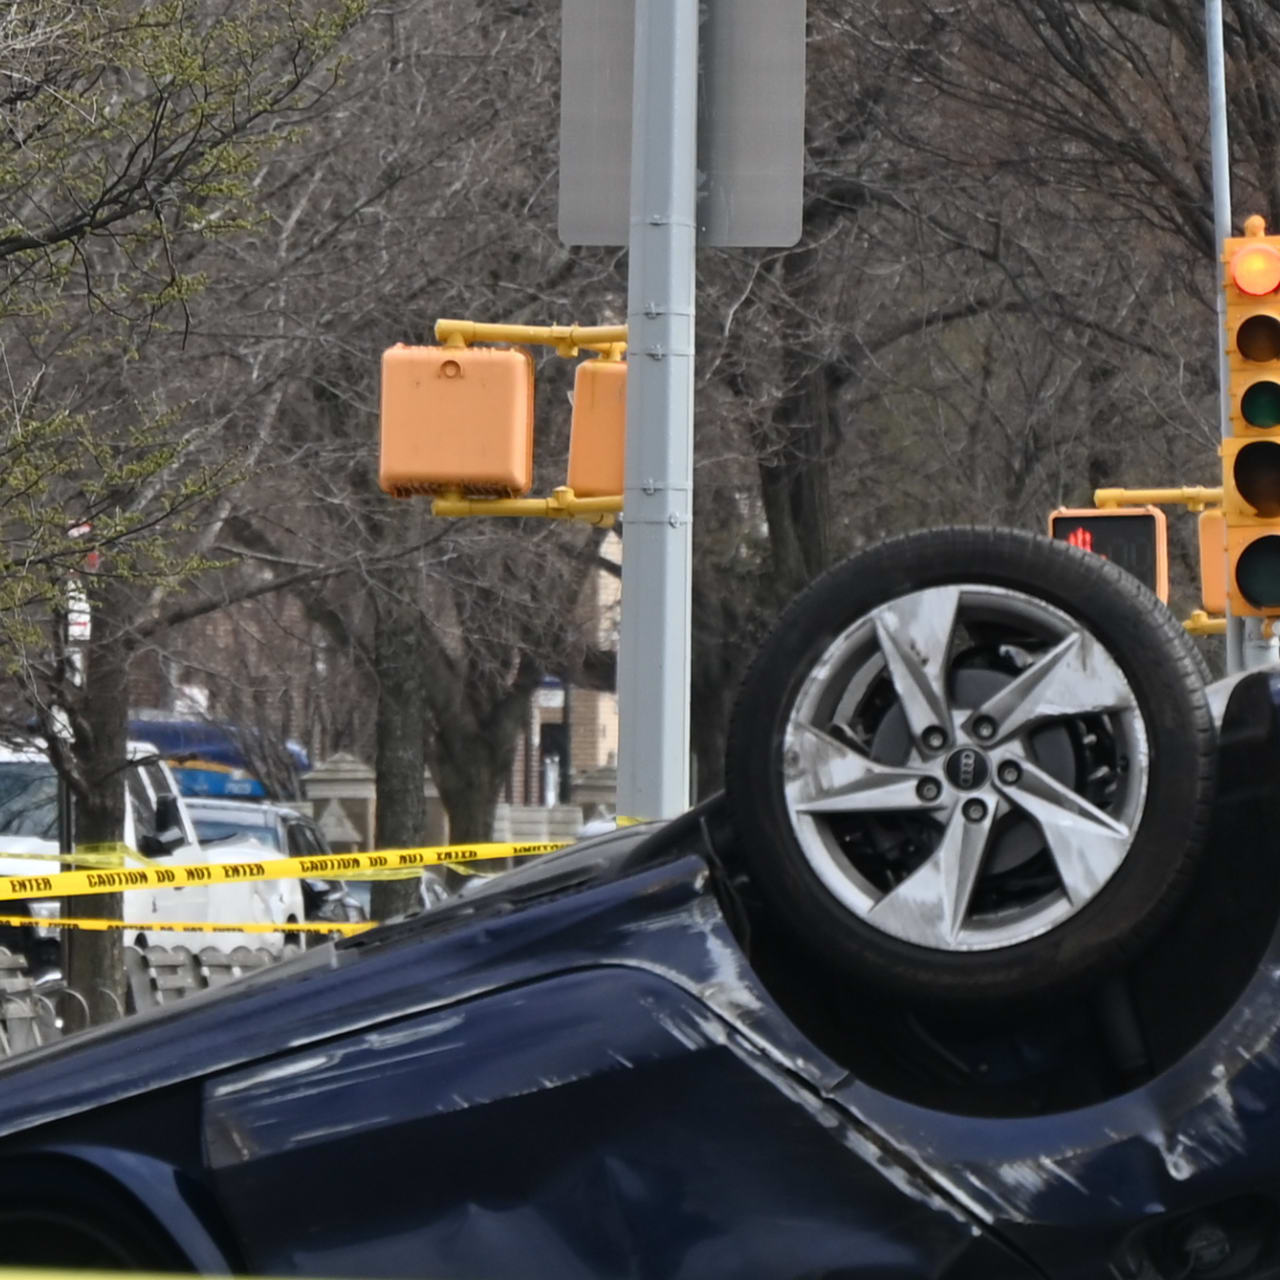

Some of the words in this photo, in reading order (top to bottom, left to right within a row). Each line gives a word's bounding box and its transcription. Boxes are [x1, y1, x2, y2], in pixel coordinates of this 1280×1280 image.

[10, 878, 52, 893] ENTER
[87, 871, 148, 888] CAUTION
[155, 870, 175, 883] DO
[185, 867, 211, 880] NOT
[222, 864, 265, 878] ENTER
